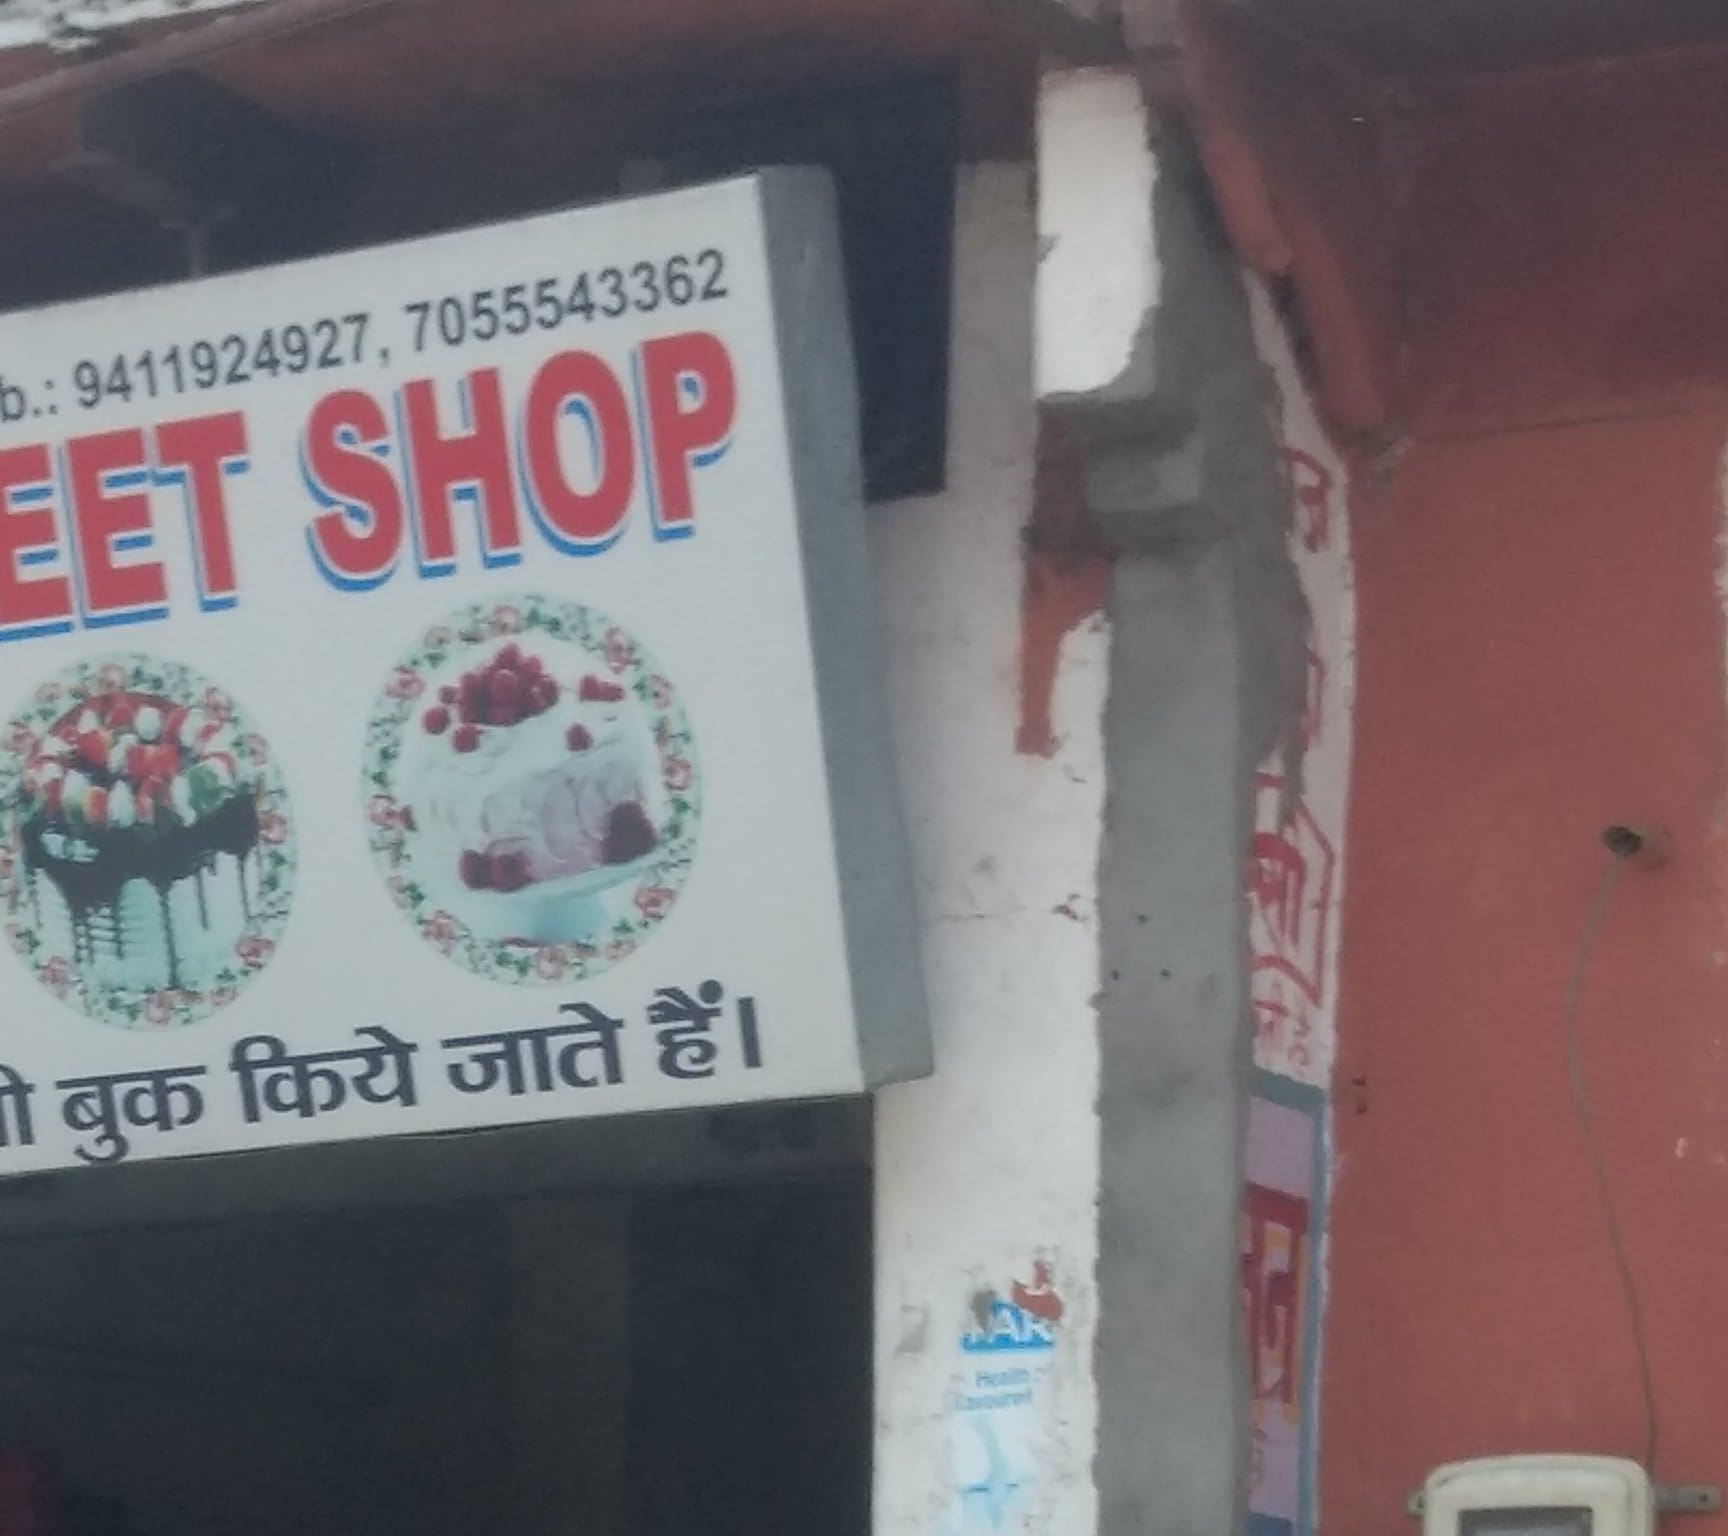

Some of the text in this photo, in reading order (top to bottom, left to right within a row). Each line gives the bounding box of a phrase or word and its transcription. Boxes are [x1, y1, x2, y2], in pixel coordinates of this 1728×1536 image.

[77, 314, 390, 411] 9411924927,
[405, 248, 730, 355] 7055543362
[300, 330, 738, 594] SHOP
[56, 1066, 208, 1165] बुक
[230, 1023, 418, 1125] किये
[445, 1000, 625, 1101] जाते
